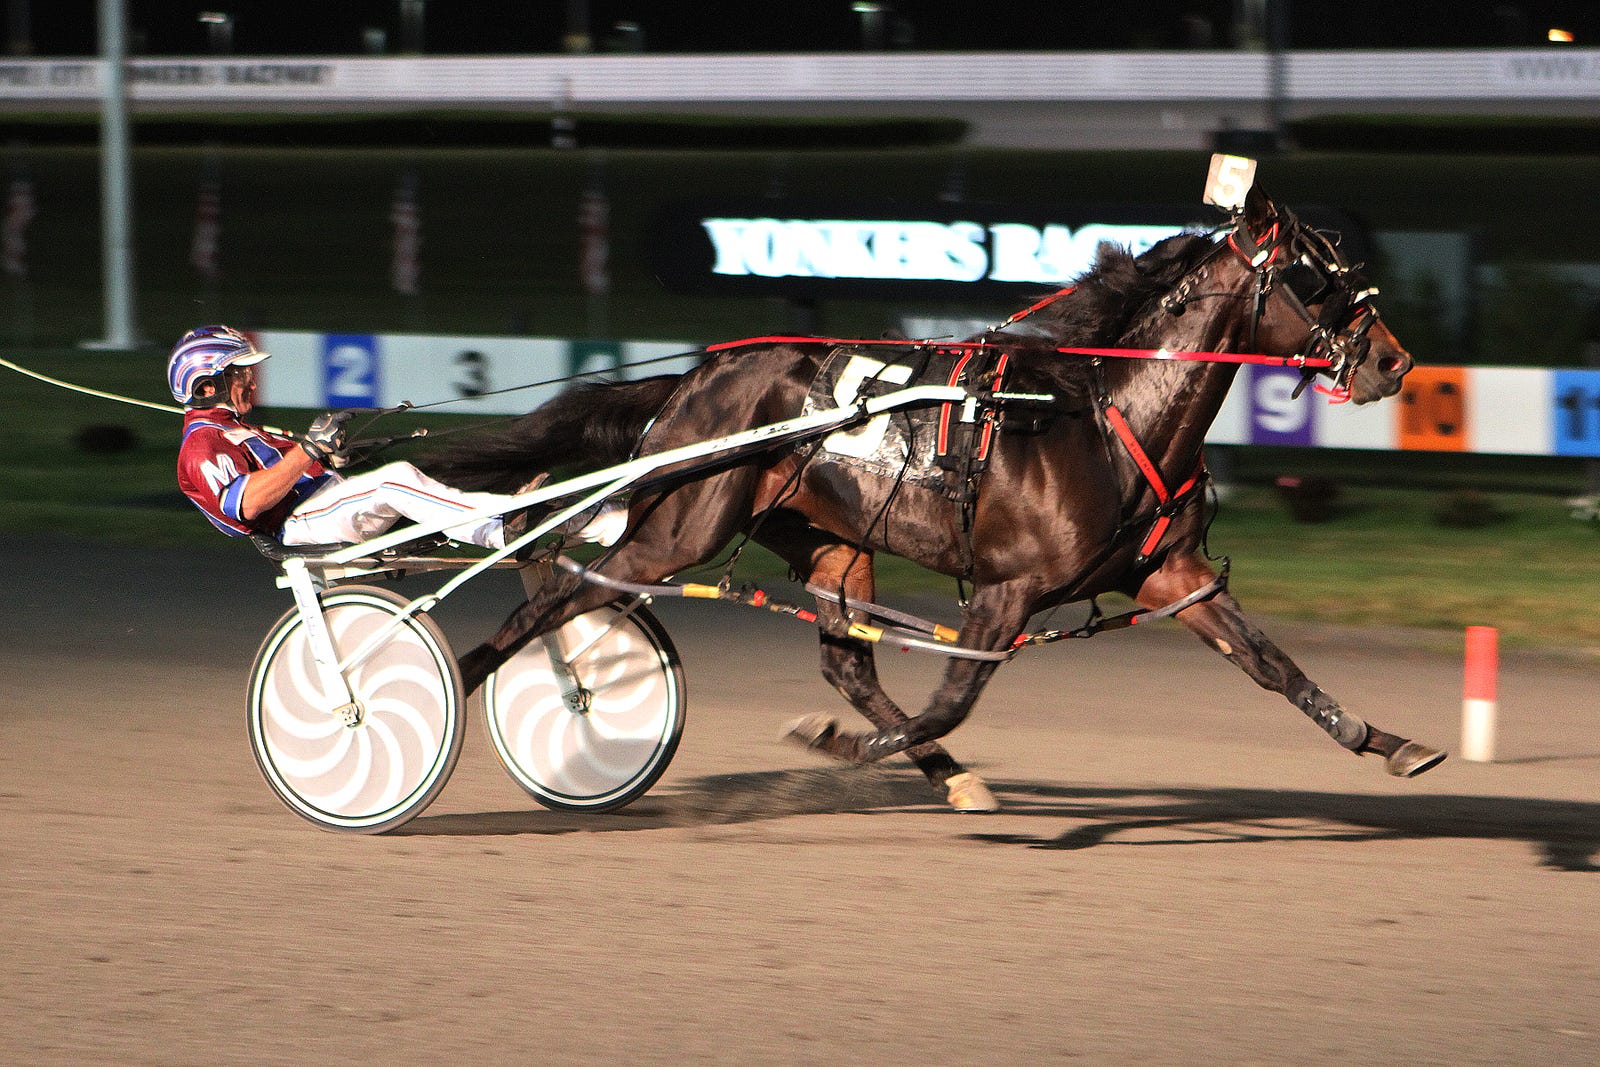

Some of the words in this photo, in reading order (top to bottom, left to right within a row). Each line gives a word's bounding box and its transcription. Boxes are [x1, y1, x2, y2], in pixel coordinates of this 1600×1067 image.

[1212, 154, 1249, 208] 5
[701, 217, 989, 282] YONKERS
[328, 346, 372, 397] 2
[451, 350, 492, 400] 3
[822, 355, 913, 459] 5
[1255, 373, 1310, 433] 9
[200, 454, 240, 496] M
